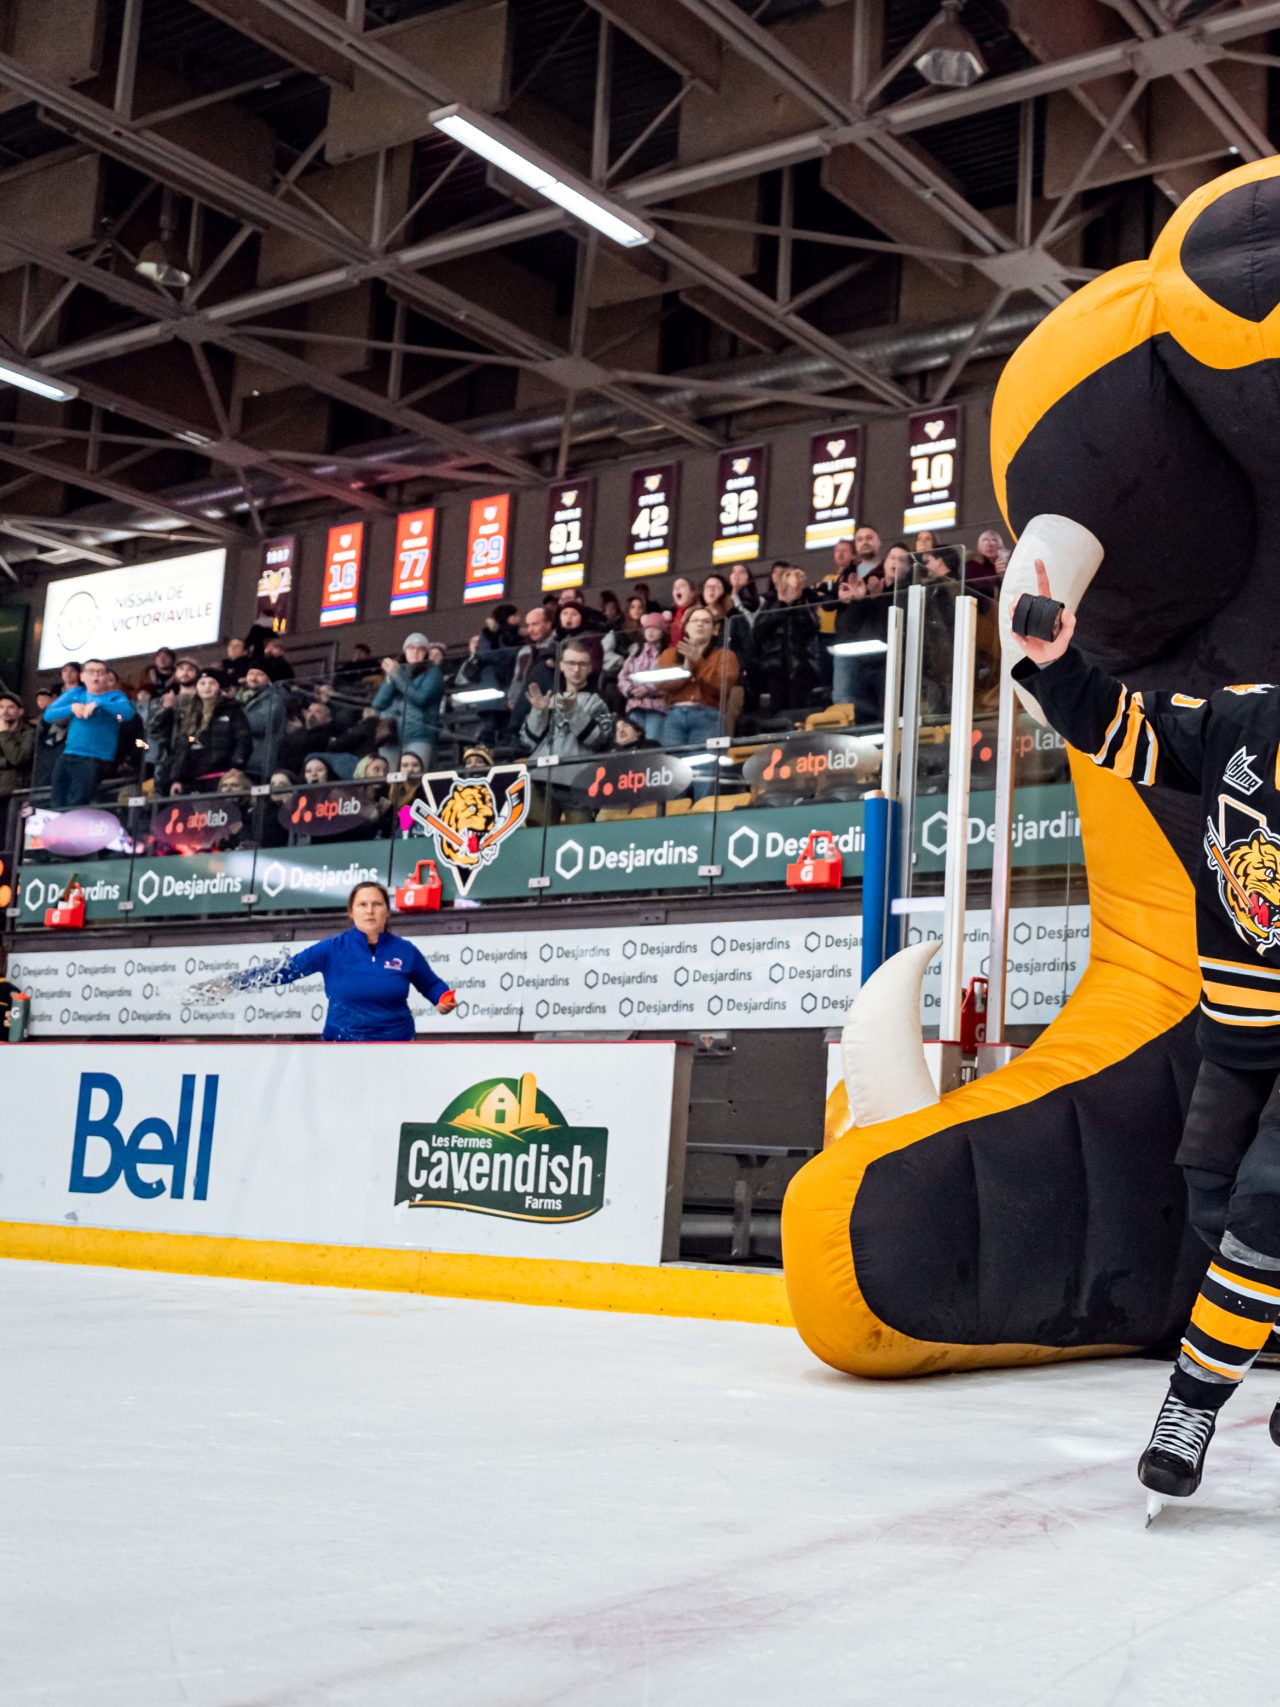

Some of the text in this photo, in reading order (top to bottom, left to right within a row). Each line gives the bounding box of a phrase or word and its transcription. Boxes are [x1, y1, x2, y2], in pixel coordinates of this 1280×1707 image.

[911, 453, 953, 493] 10
[812, 471, 855, 509] 97
[719, 489, 758, 525] 32
[631, 505, 669, 539] 42
[549, 521, 582, 554] 91
[471, 535, 504, 567] 29
[399, 548, 429, 580] 77
[328, 562, 357, 592] 16
[116, 584, 185, 608] NISSAN DE
[112, 602, 213, 631] VICTORIAVILLE
[796, 749, 858, 776] atplab
[617, 766, 673, 792] atplab
[315, 796, 361, 819] atplab
[188, 808, 228, 831] atplab
[589, 841, 698, 873] Desjardins
[290, 863, 377, 891] Desjardins
[163, 873, 241, 900] Desjardins
[556, 944, 610, 960] Desjardins
[641, 941, 697, 957] Desjardins
[730, 937, 790, 953] Desjardins
[476, 948, 527, 964] Desjardins
[22, 965, 58, 978] Desjardins
[78, 963, 116, 976] Desjardins
[137, 962, 176, 974] Desjardins
[199, 960, 239, 973] Desjardins
[789, 964, 852, 982] Desjardins
[516, 974, 570, 990] Desjardins
[602, 971, 658, 987] Desjardins
[693, 968, 752, 985] Desjardins
[35, 988, 71, 1000] Desjardins
[94, 986, 132, 1000] Desjardins
[258, 1006, 302, 1021] Desjardins
[472, 1003, 524, 1018] Desjardins
[553, 1001, 606, 1017] Desjardins
[637, 999, 694, 1015] Desjardins
[727, 998, 787, 1014] Desjardins
[72, 1011, 110, 1023] Desjardins
[131, 1010, 171, 1023] Desjardins
[193, 1009, 235, 1023] Desjardins
[69, 1072, 219, 1201] Bell
[432, 1135, 492, 1149] Les Fermes
[408, 1140, 593, 1196] Cavendish
[525, 1196, 562, 1211] Farms
